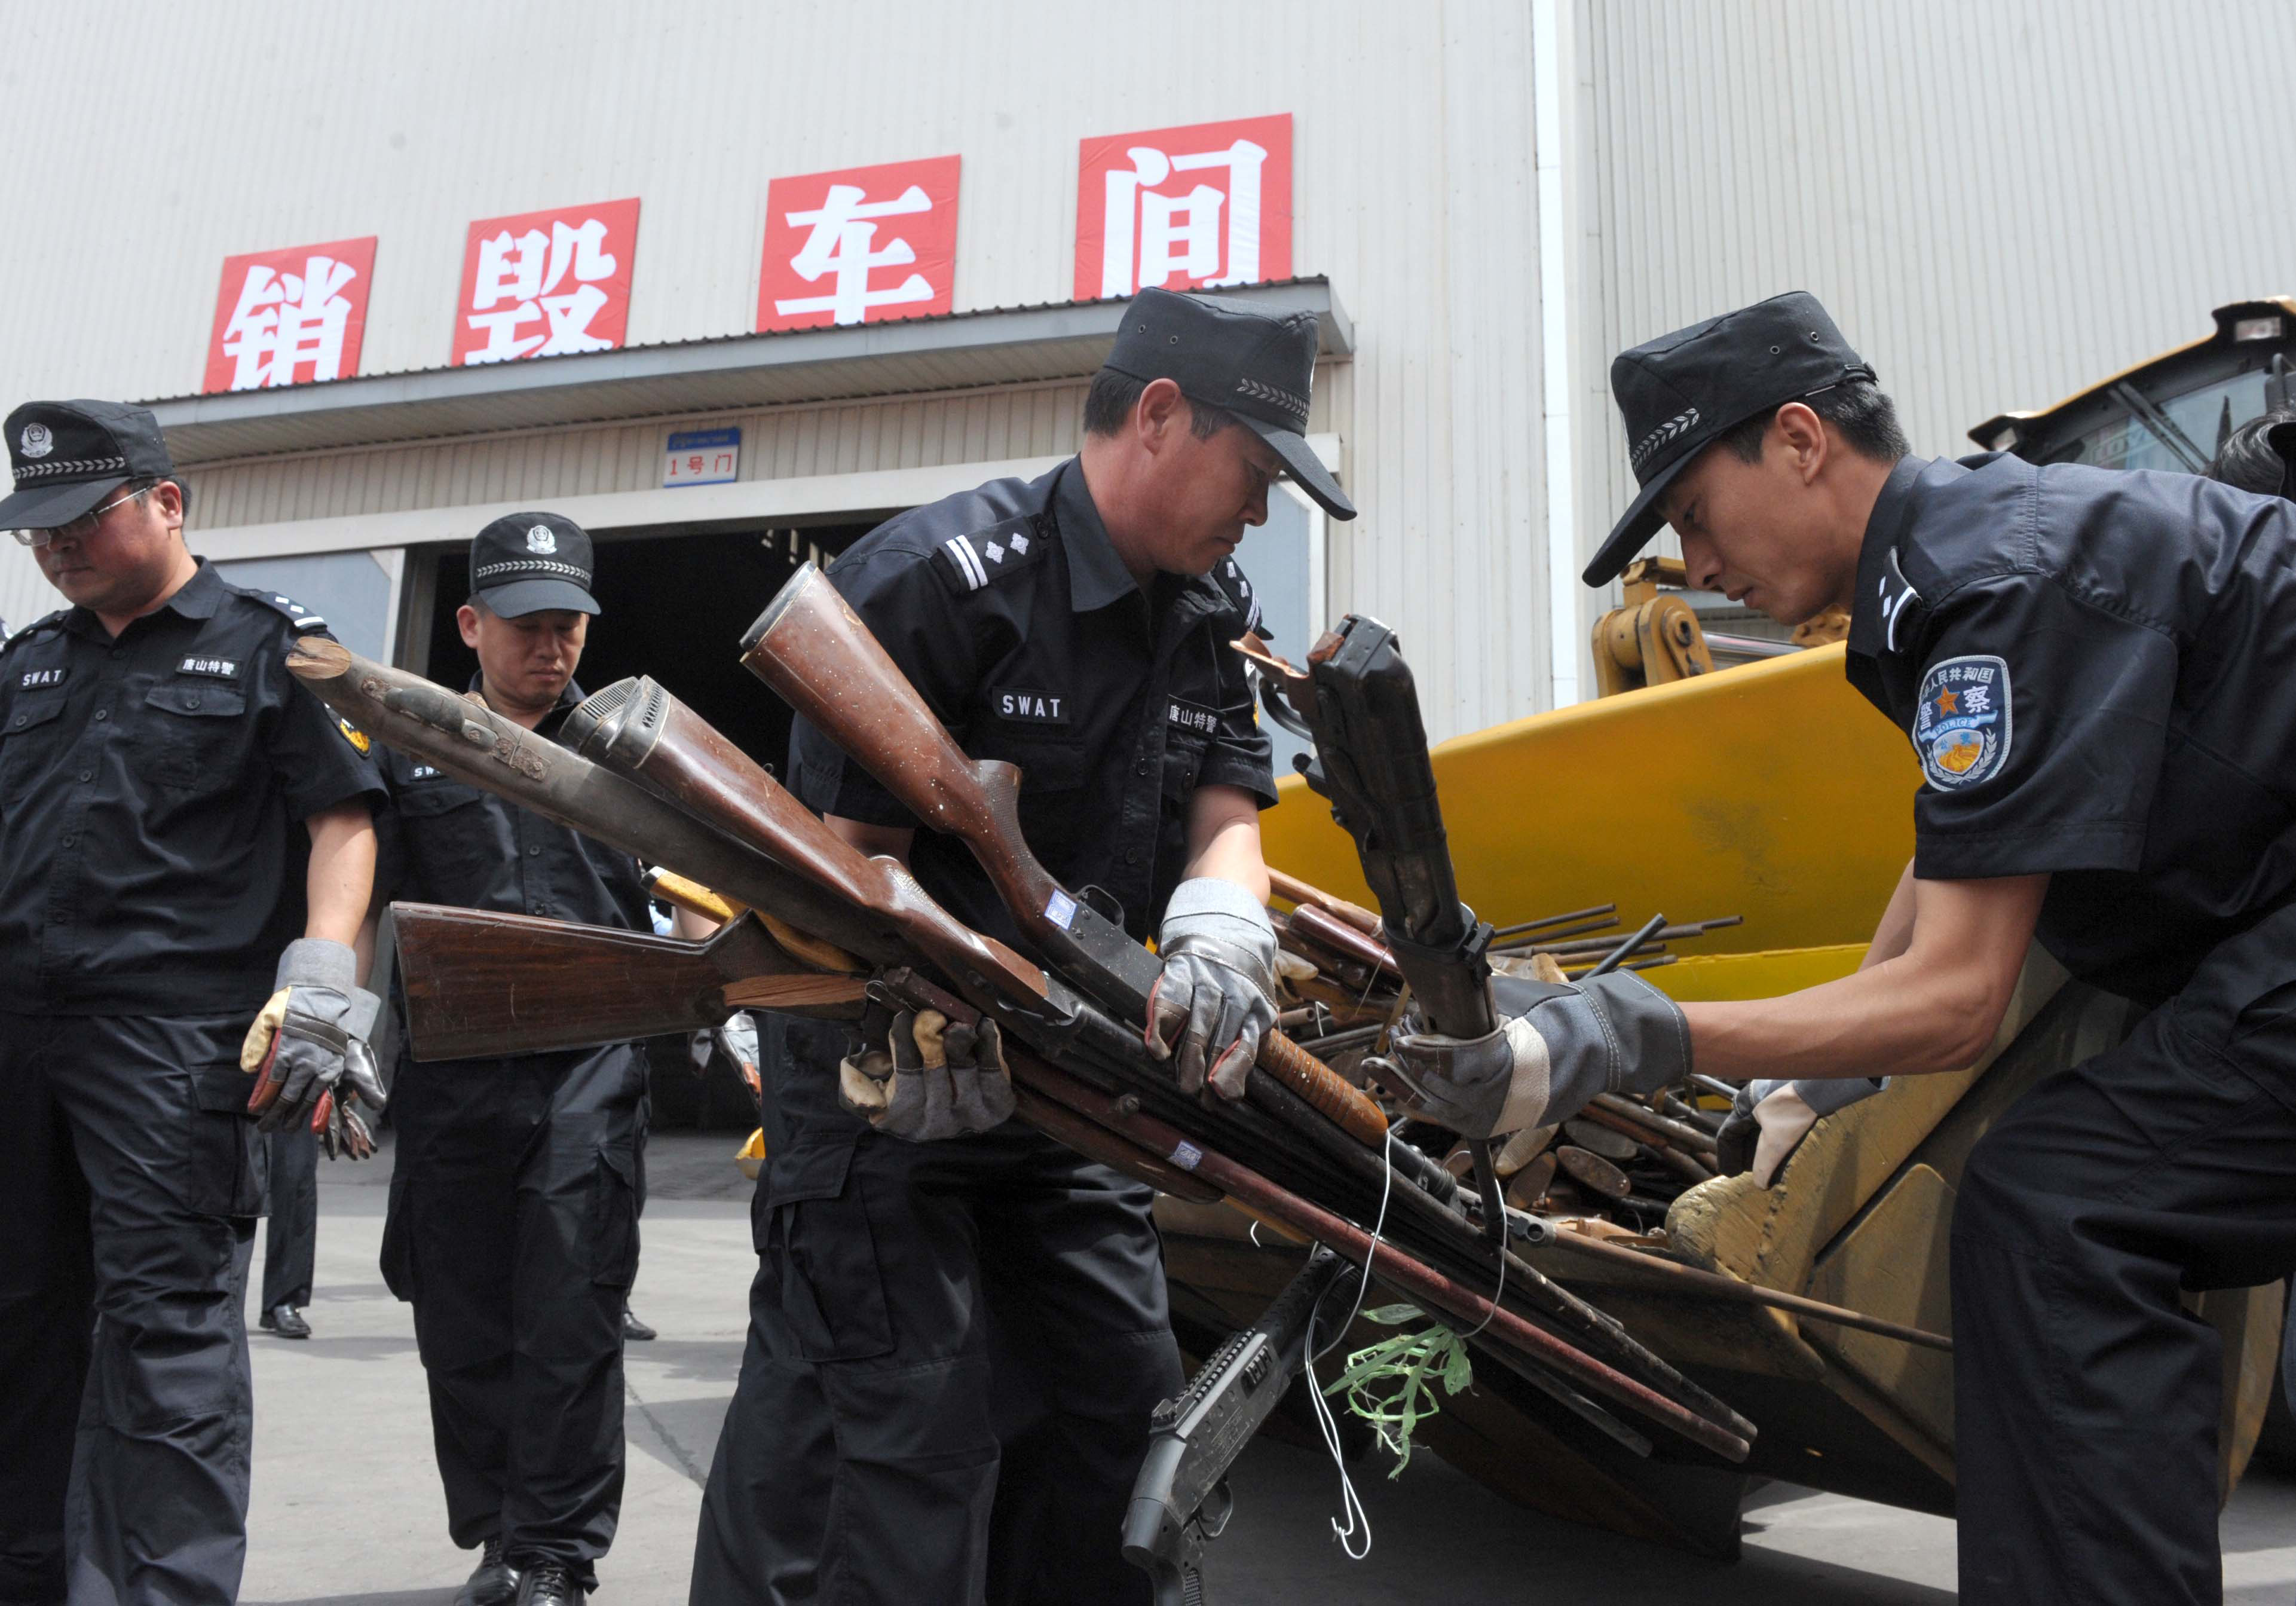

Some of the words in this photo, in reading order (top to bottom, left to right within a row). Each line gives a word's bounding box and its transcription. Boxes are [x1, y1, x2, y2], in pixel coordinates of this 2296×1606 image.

[222, 139, 1268, 392] 销毁车间
[671, 454, 732, 476] 1号门
[23, 669, 62, 686] SWAT
[183, 658, 235, 675] 唐山特警
[1922, 666, 1995, 702] 华人民共和国
[1002, 695, 1060, 717] SWAT
[1169, 704, 1217, 733] 唐山特警
[1935, 718, 1972, 735] POLICE
